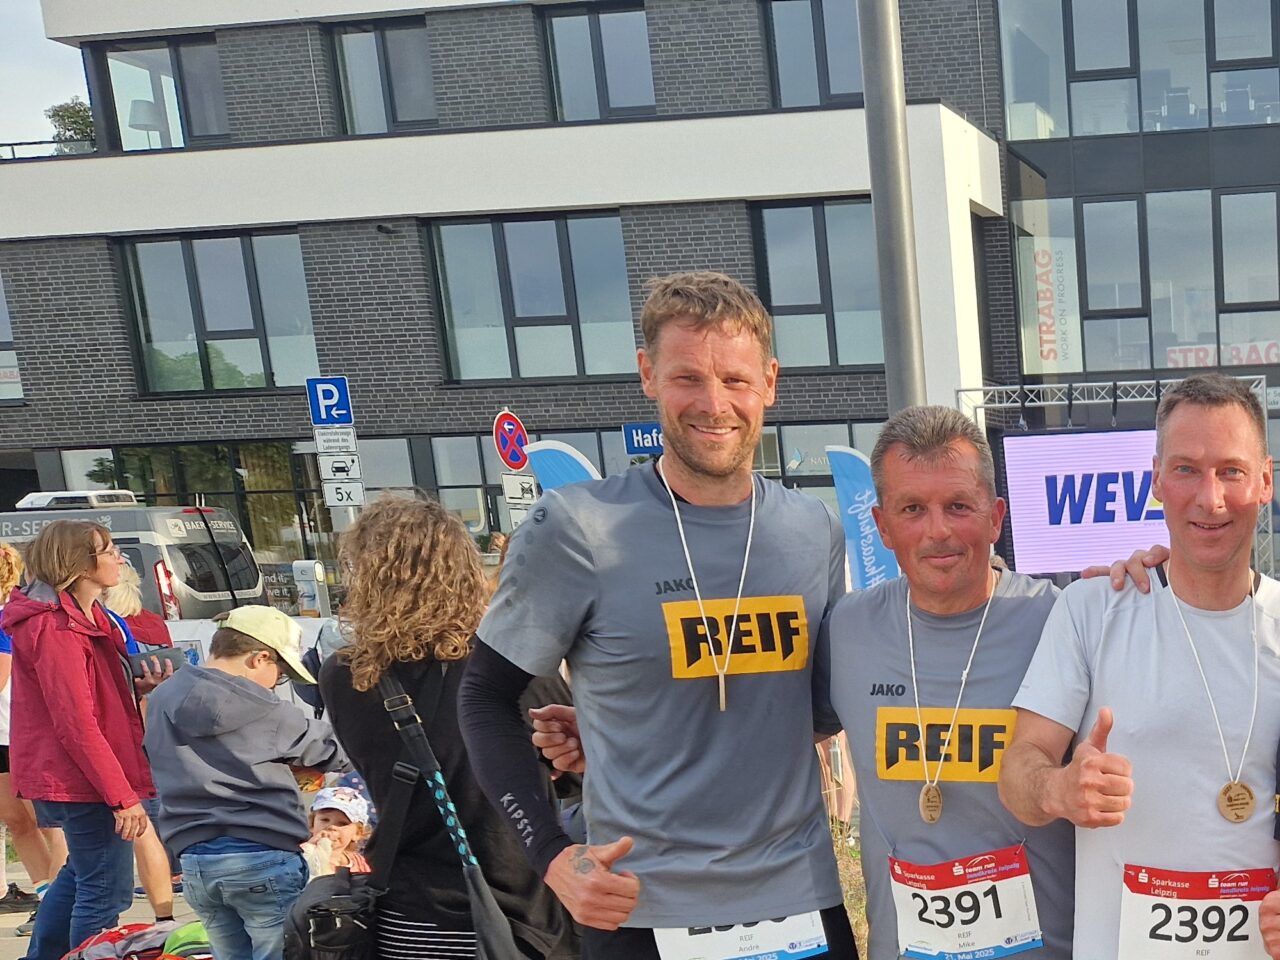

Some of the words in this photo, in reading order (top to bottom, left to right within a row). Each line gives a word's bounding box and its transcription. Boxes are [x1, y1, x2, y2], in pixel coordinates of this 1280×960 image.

[1055, 250, 1065, 304] PROGRESS
[1034, 249, 1057, 361] STRABAG
[1059, 309, 1068, 327] ON
[1060, 329, 1069, 361] WORK
[1166, 342, 1280, 368] STRBAG
[316, 383, 339, 419] P
[335, 487, 354, 502] 5x
[655, 578, 697, 595] JAKO
[680, 611, 800, 669] REIF
[870, 683, 906, 697] JAKO
[885, 722, 1007, 773] REIF
[500, 792, 536, 848] KIPSTA
[902, 870, 935, 881] Sparkasse
[905, 879, 927, 890] Leipzig
[1151, 877, 1190, 889] Sparkasse
[1151, 887, 1177, 899] Leipzig
[911, 884, 1003, 929] 2391
[1149, 902, 1249, 943] 2392
[958, 941, 975, 949] Mike
[1196, 949, 1211, 957] REIF
[944, 953, 957, 960] 21.
[957, 951, 973, 960] Mai
[974, 949, 994, 959] 2025
